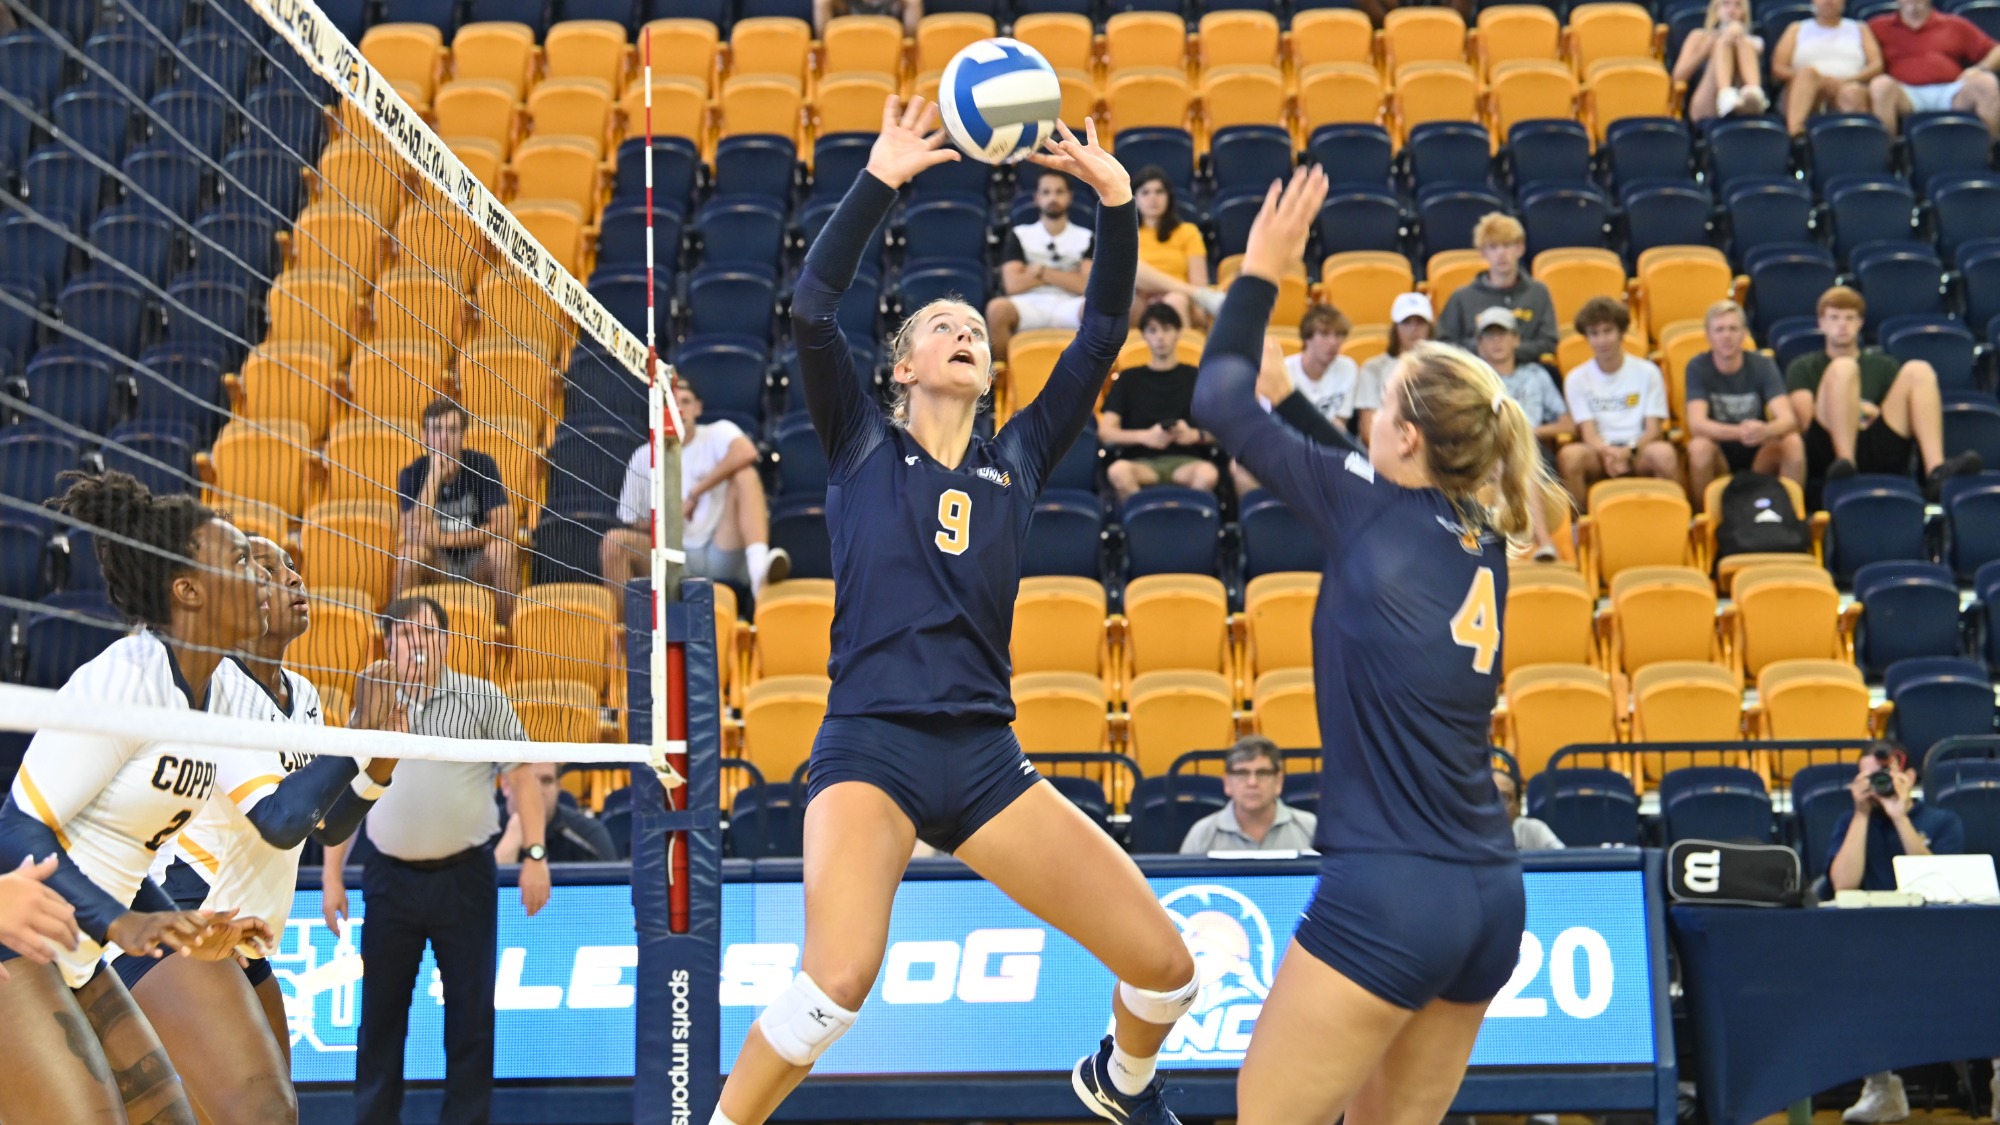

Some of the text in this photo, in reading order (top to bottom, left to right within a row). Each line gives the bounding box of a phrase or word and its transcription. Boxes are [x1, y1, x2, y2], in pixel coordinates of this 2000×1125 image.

[934, 488, 972, 556] 9
[1450, 565, 1500, 675] 4
[144, 808, 192, 851] 2
[1483, 925, 1614, 1019] 20
[668, 969, 692, 1125] sports imports
